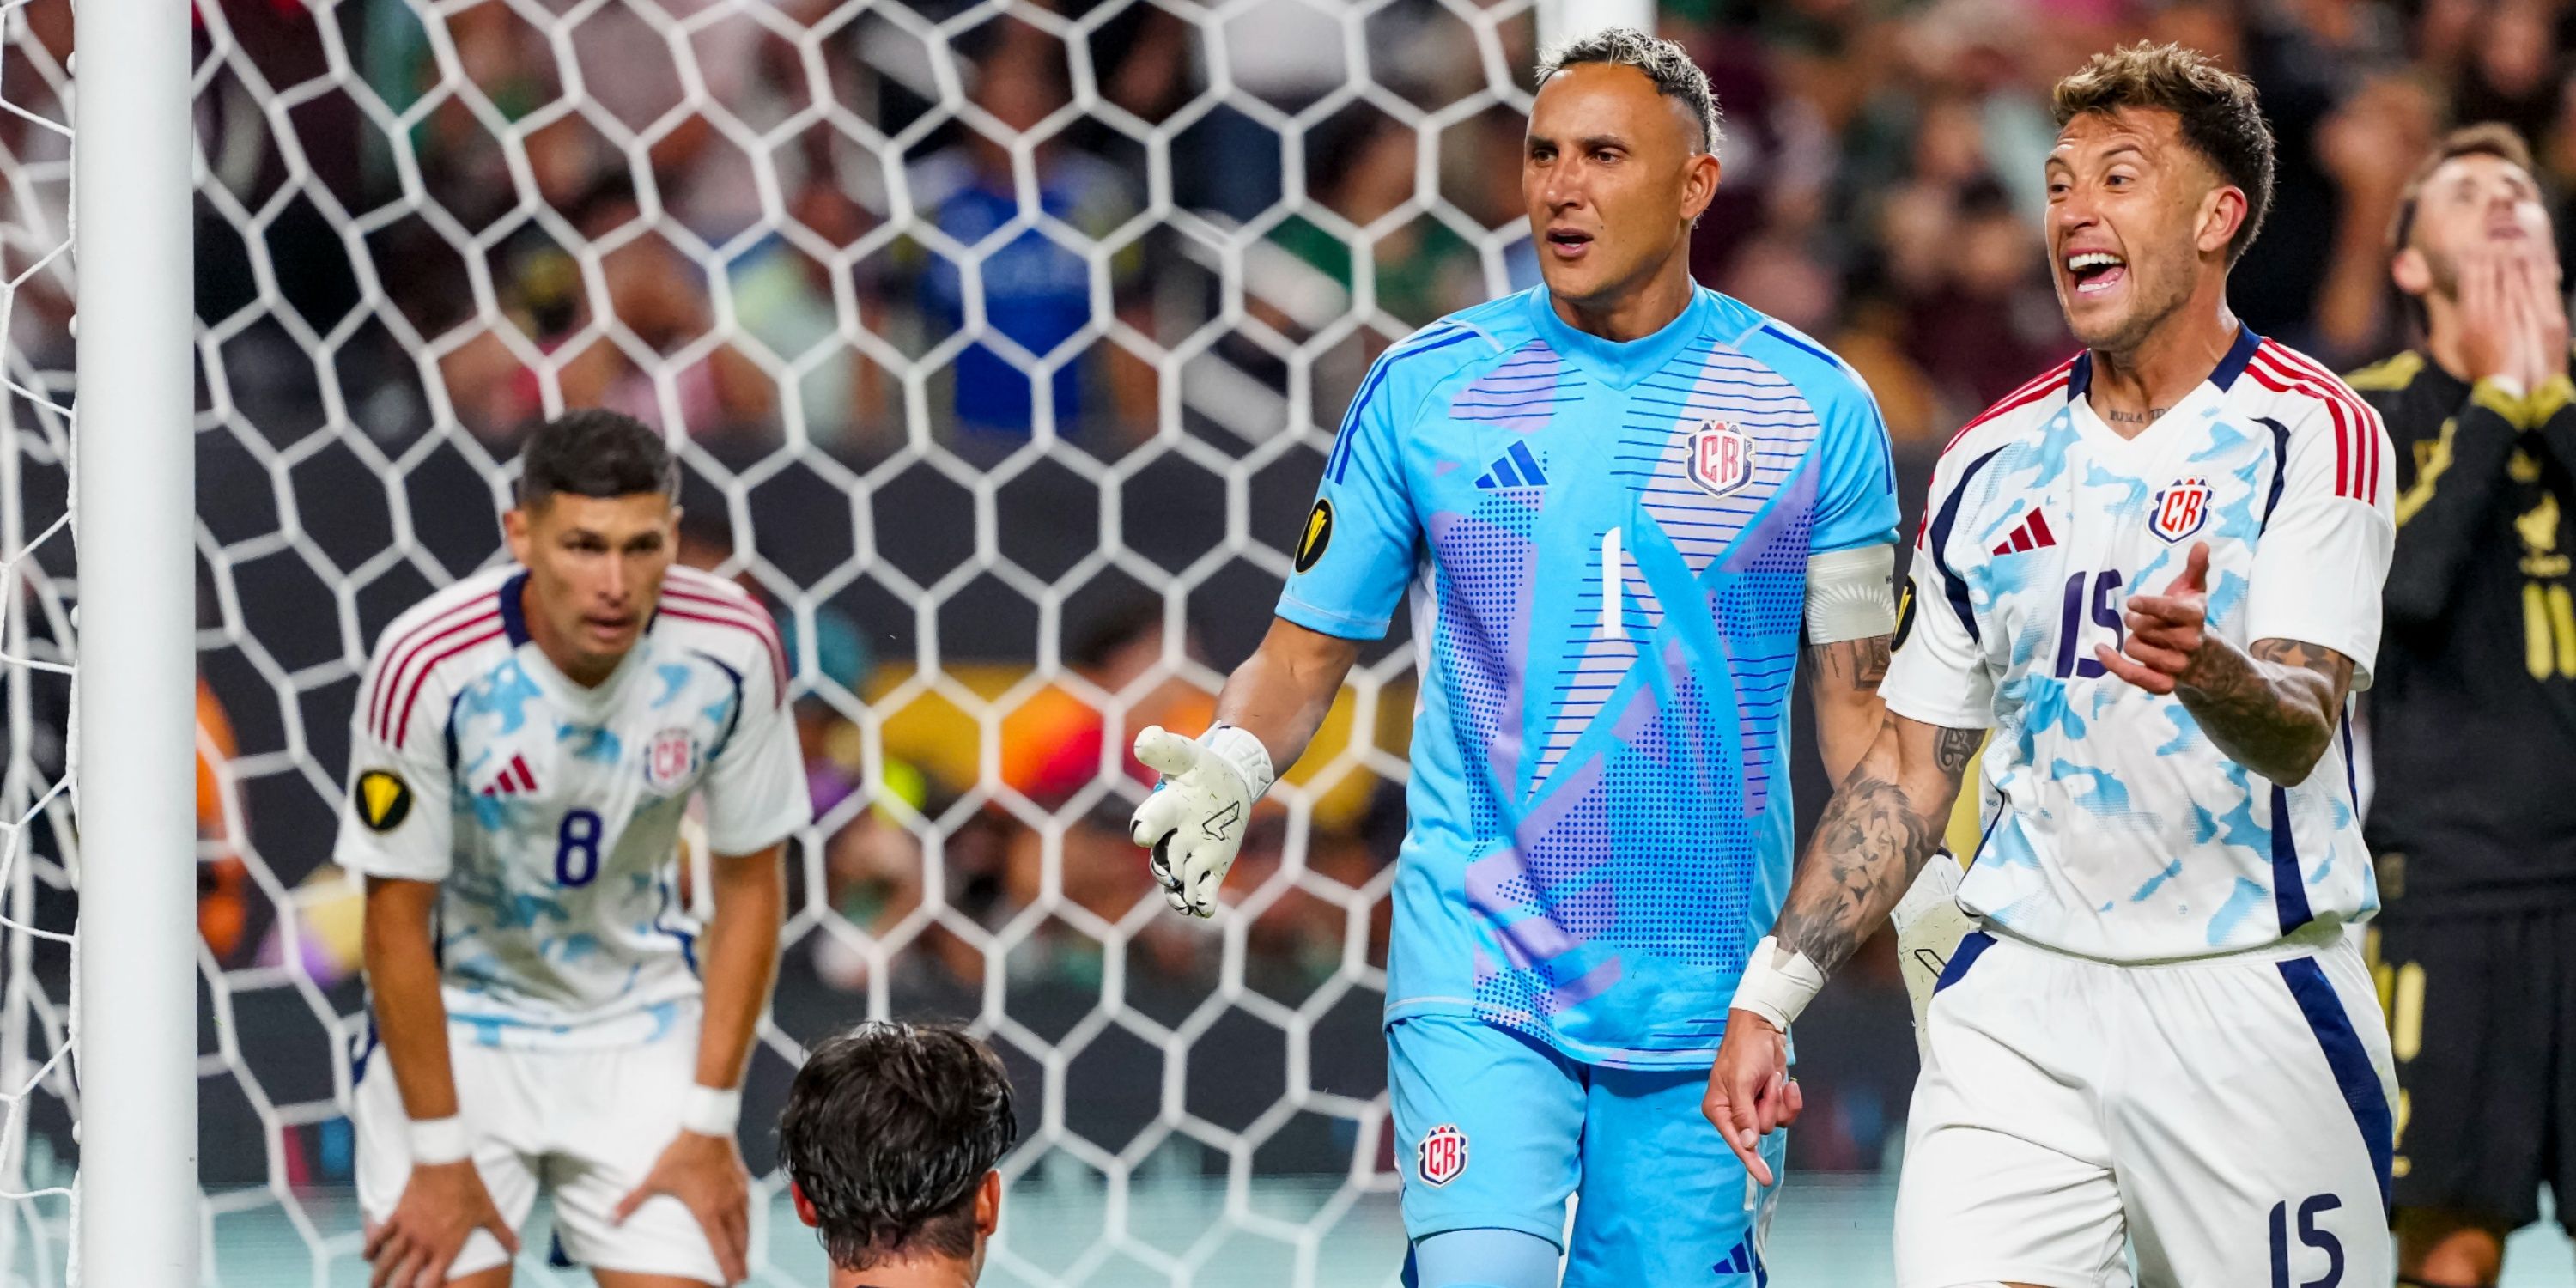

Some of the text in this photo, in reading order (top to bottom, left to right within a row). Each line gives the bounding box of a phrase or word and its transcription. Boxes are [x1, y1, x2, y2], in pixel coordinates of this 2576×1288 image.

[1701, 434, 1739, 483] CR
[2161, 490, 2203, 532] CR
[1602, 526, 1622, 640] 1
[2055, 568, 2124, 679] 15
[555, 809, 602, 887] 8
[1429, 1137, 1455, 1176] CR
[2269, 1193, 2344, 1288] 15
